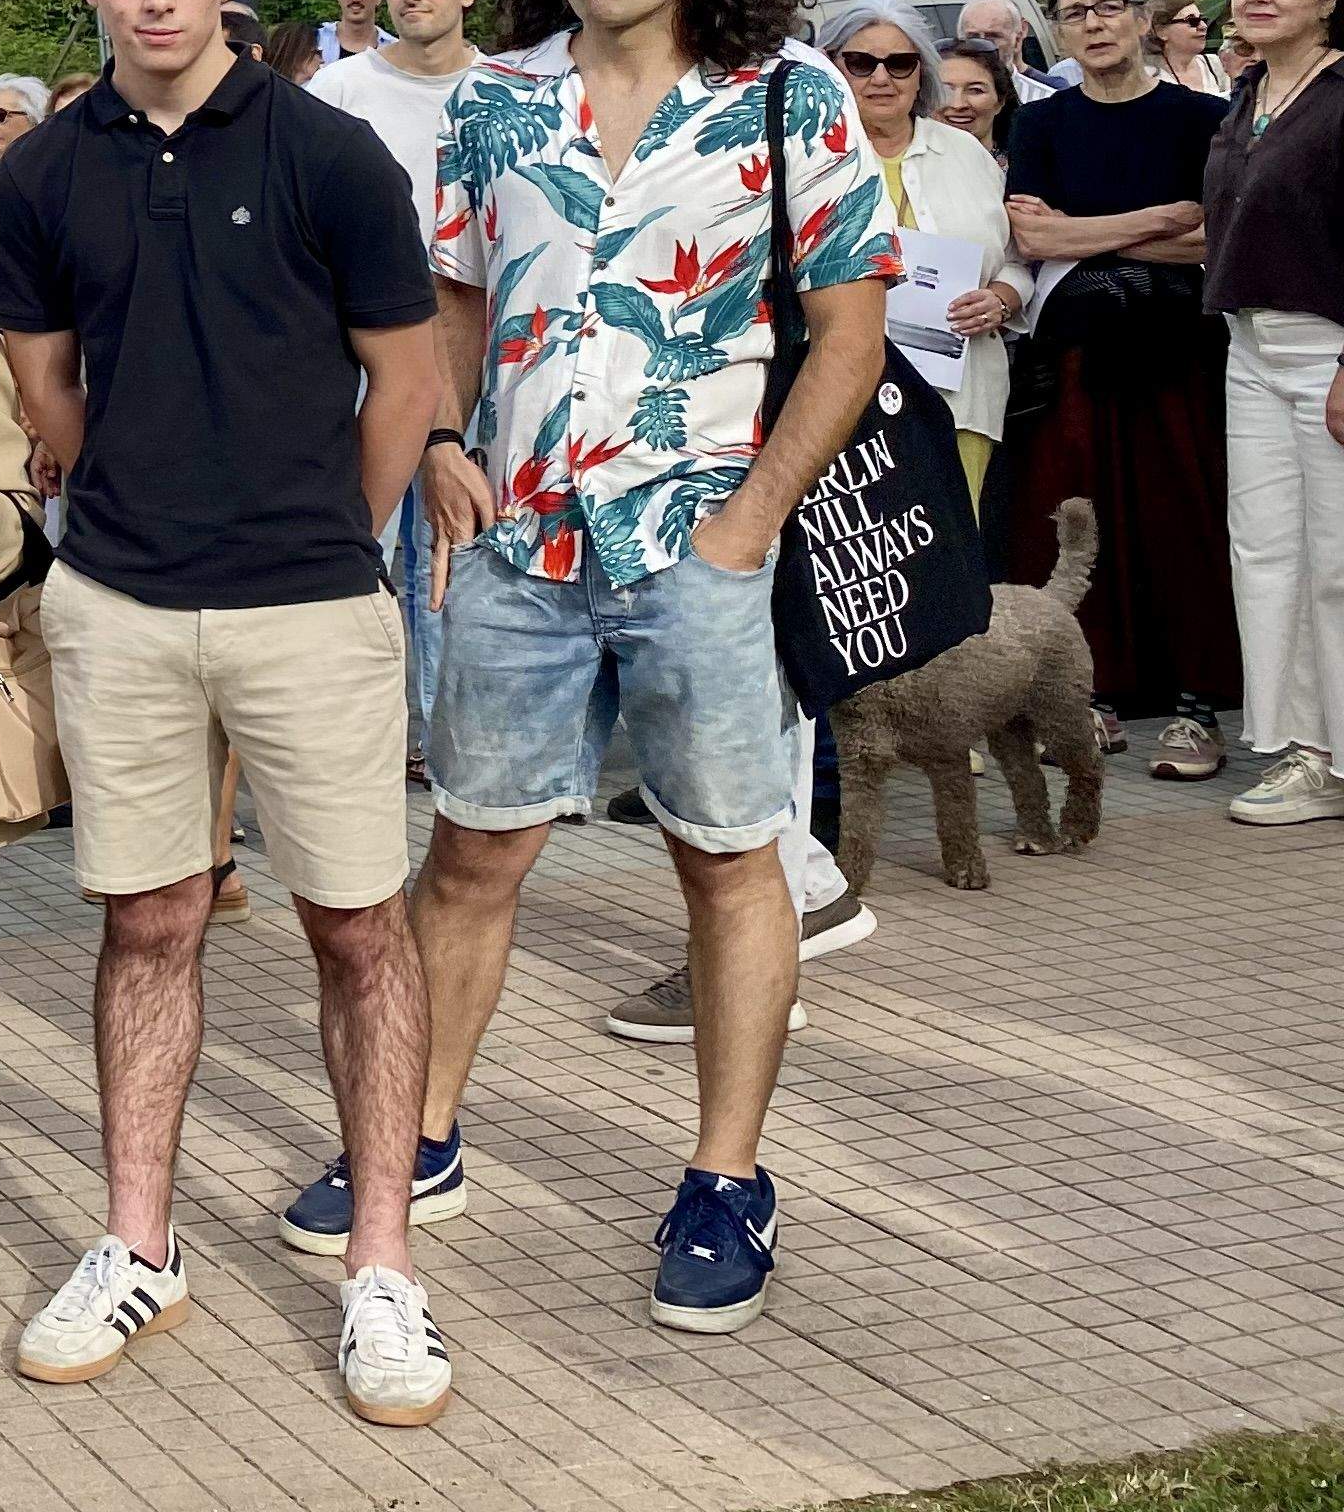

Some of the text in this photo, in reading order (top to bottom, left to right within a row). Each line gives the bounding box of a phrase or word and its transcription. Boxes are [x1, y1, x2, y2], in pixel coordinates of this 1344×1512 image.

[799, 430, 895, 506] RLIN
[810, 504, 933, 595] ALWAYS
[819, 569, 909, 637] NEED
[830, 614, 907, 676] YOU
